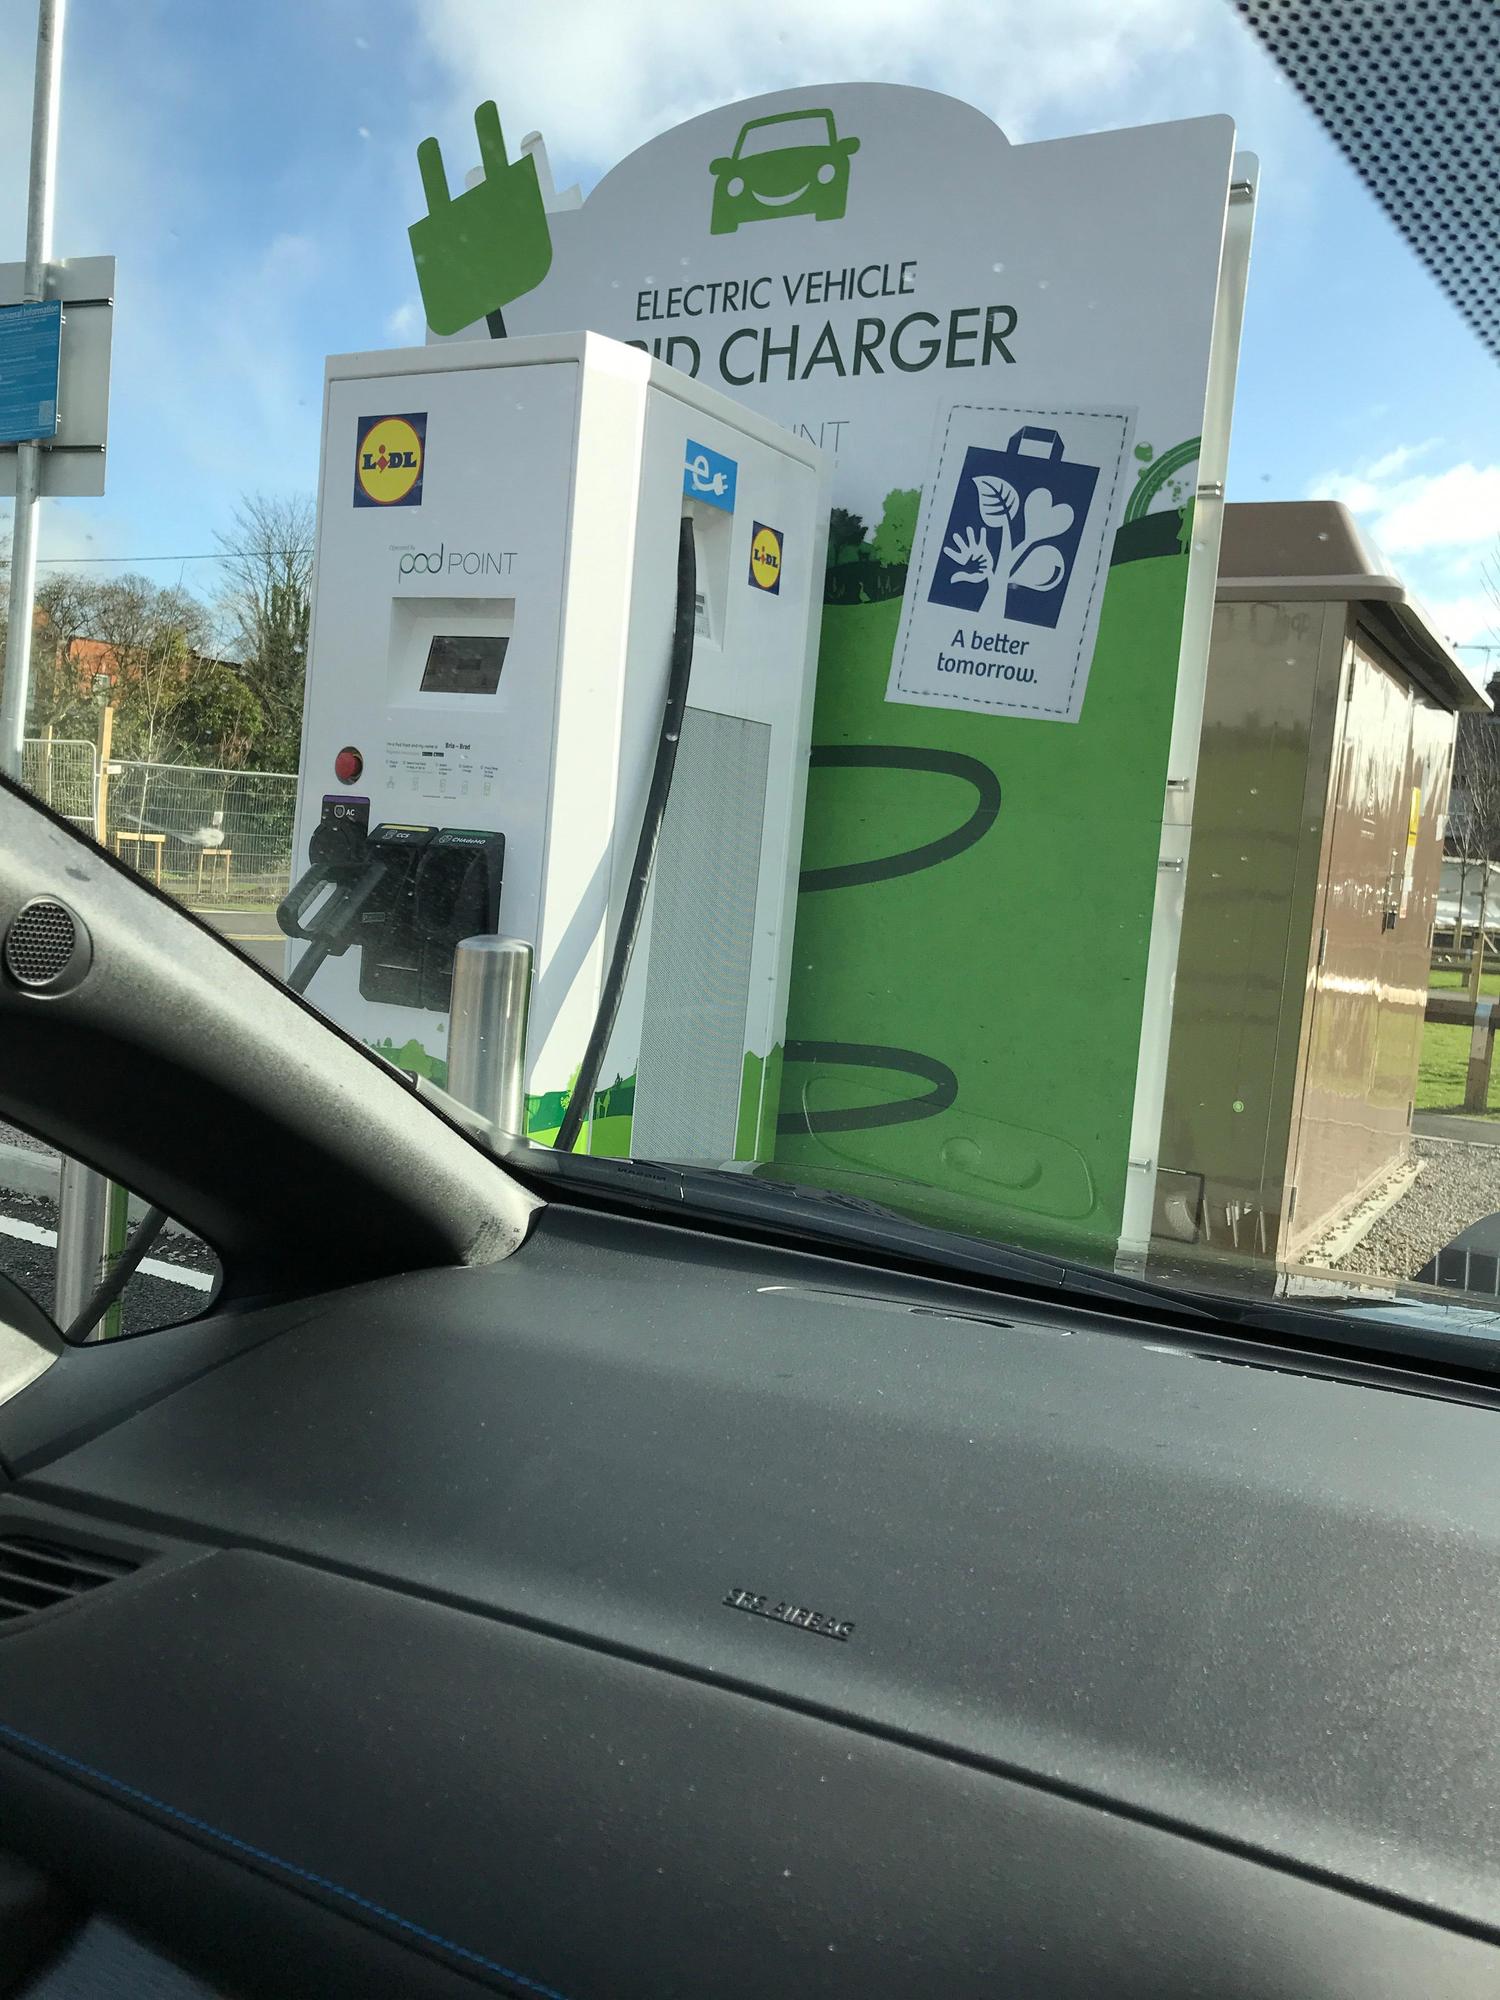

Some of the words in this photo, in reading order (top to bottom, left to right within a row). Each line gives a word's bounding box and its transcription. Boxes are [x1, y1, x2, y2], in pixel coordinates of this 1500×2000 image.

[636, 277, 772, 322] ELECTRIC
[782, 261, 918, 306] VEHICLE
[718, 304, 1019, 386] CHARGER
[398, 542, 444, 584] pod
[447, 552, 518, 575] POINT
[951, 629, 965, 649] A
[971, 630, 1030, 656] better
[937, 652, 1038, 684] tomorrow.
[345, 808, 355, 816] AC
[722, 1588, 768, 1611] SRS
[774, 1601, 856, 1637] AIRBAG
